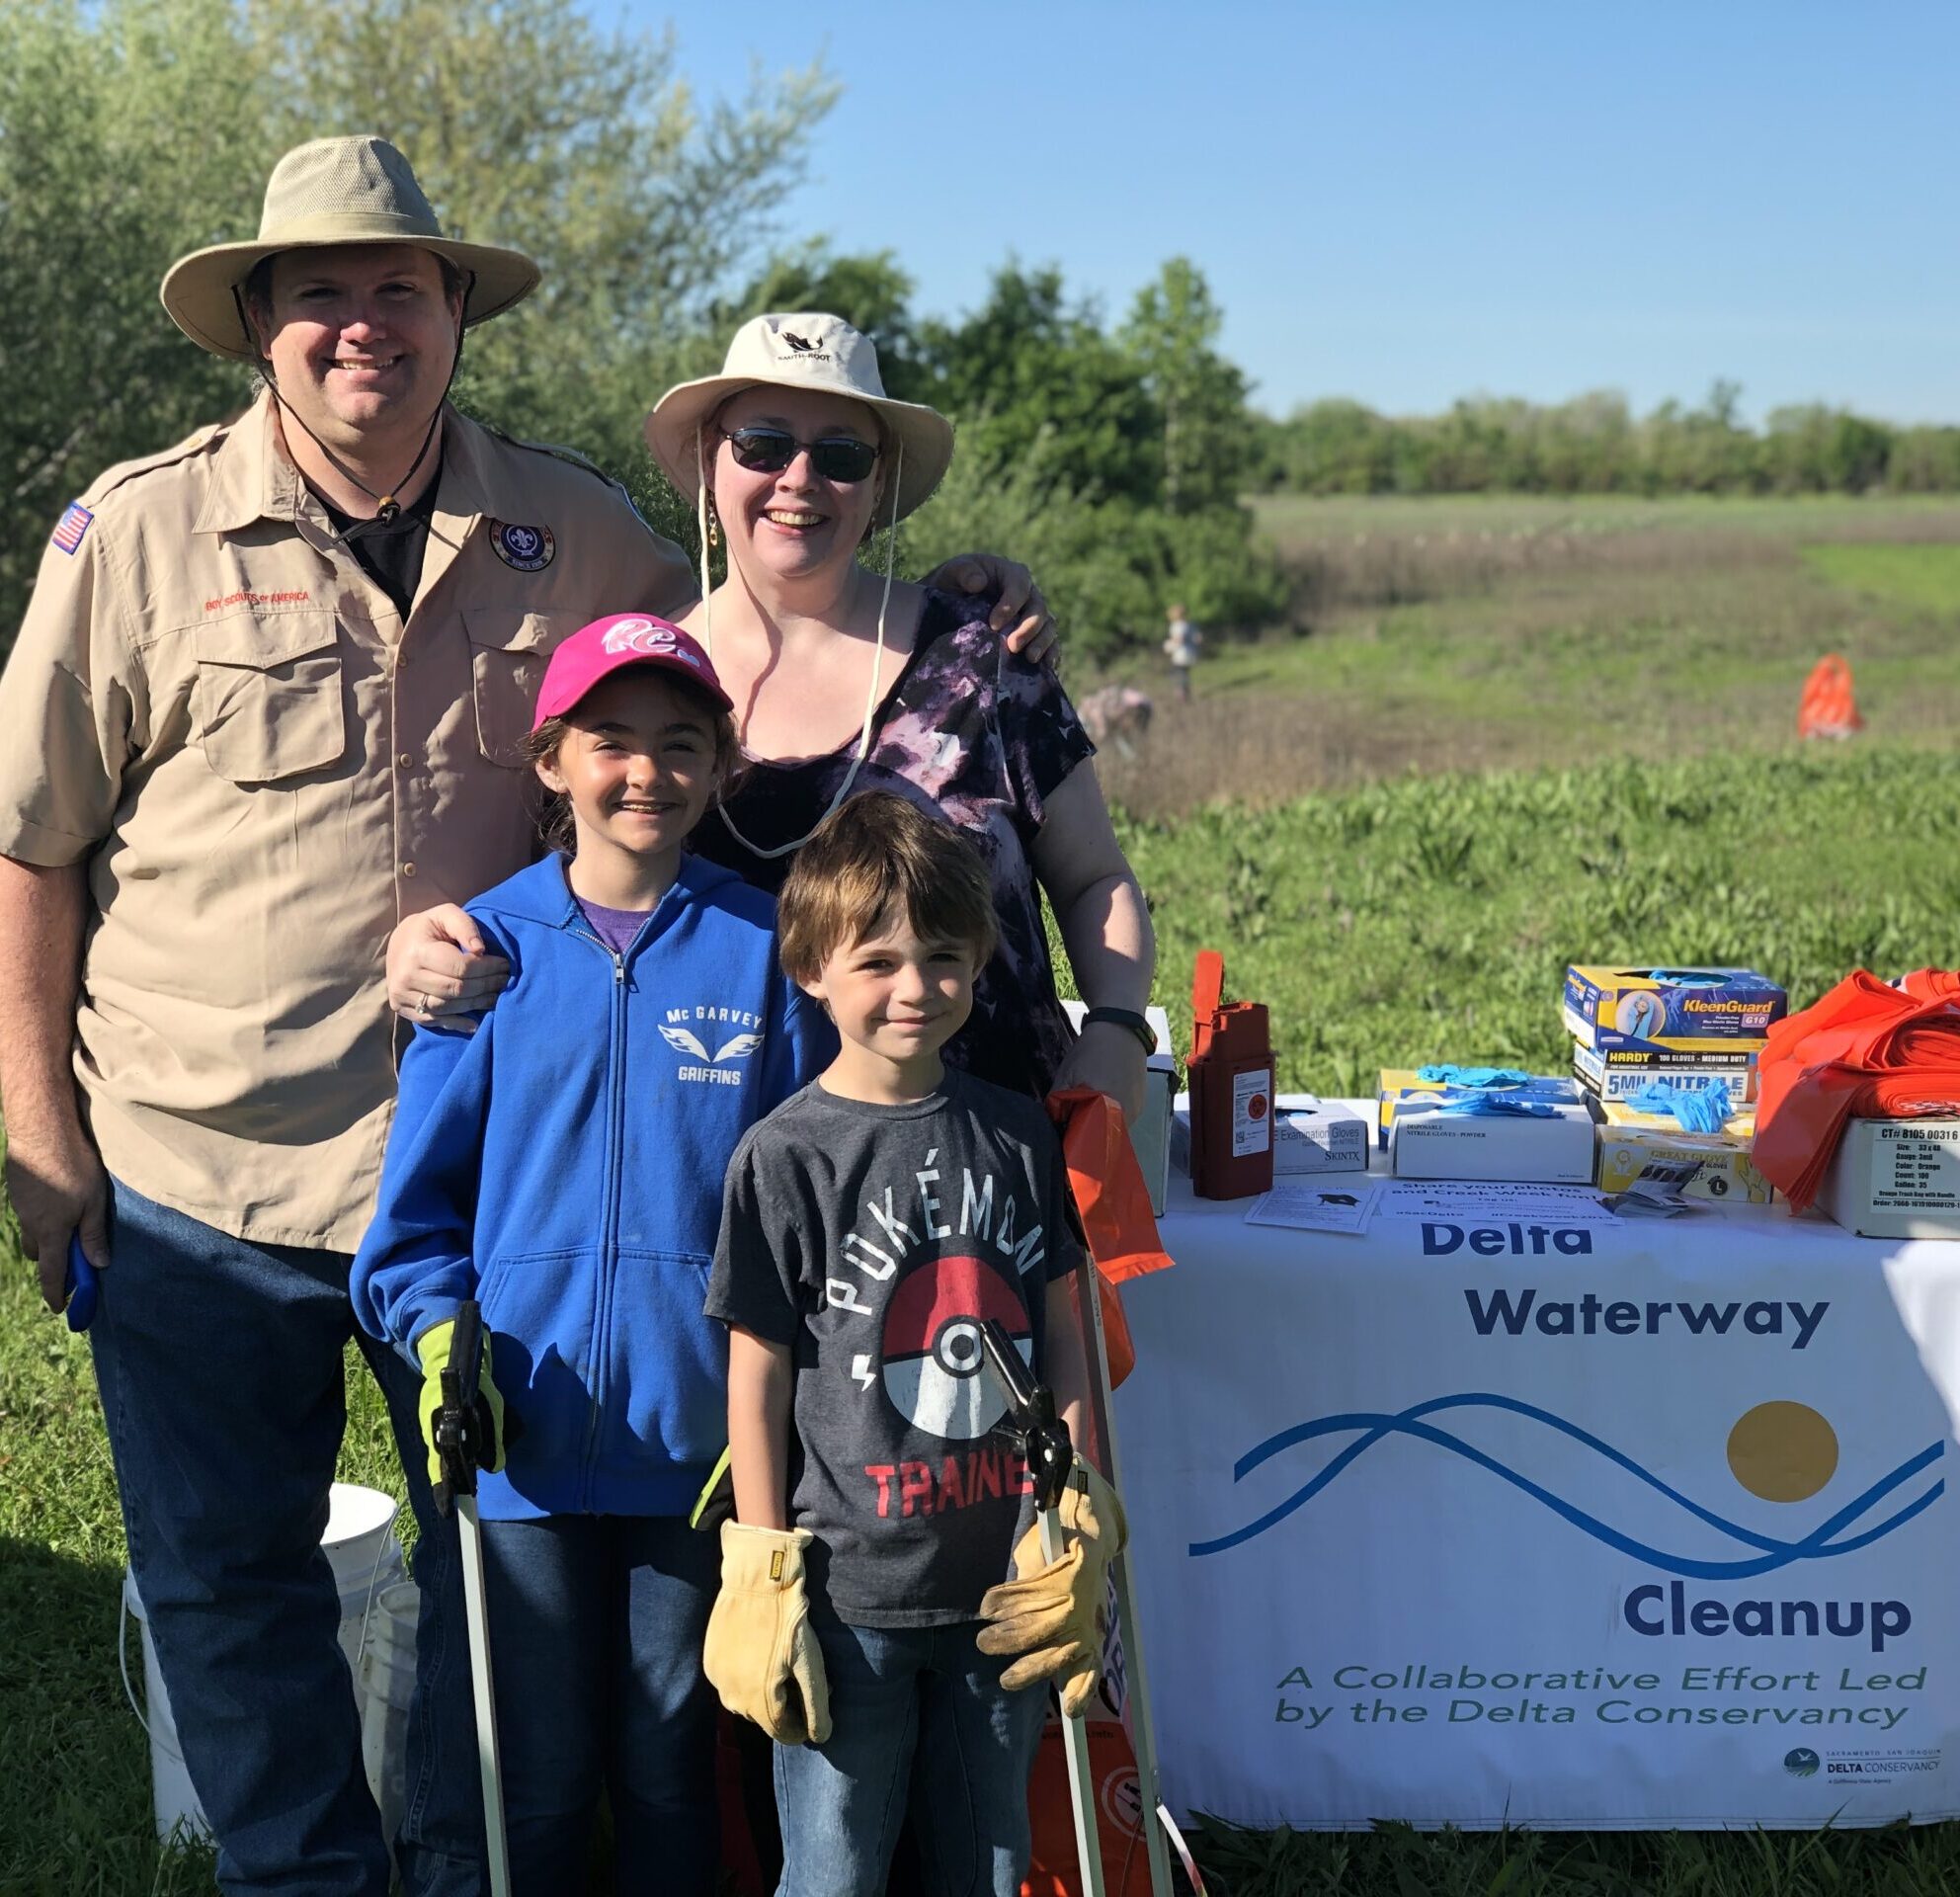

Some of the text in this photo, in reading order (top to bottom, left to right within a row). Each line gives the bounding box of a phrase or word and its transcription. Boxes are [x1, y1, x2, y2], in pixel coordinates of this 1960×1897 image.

[204, 600, 223, 612] BOY
[224, 591, 258, 607] SCOUTS
[271, 591, 309, 604] AMERICA
[1683, 999, 1774, 1014] KleenGuard
[1745, 1016, 1766, 1025] G10
[1609, 1052, 1651, 1063] HARDY
[678, 1066, 742, 1086] GRIFFINS
[1280, 1128, 1330, 1141] Examination
[1331, 1126, 1360, 1139] Gloves
[1881, 1128, 1900, 1139] CT#
[1902, 1128, 1925, 1139] 8105
[1421, 1222, 1593, 1256] Delta
[1464, 1289, 1832, 1351] Waterway
[863, 1447, 1035, 1519] TRAINE
[1624, 1581, 1913, 1653] Cleanup
[1276, 1665, 1927, 1691] A Collaborative Effort Led
[1274, 1698, 1910, 1730] by the Delta Conservancy
[1827, 1761, 1940, 1773] DELTA CONSERVANCY
